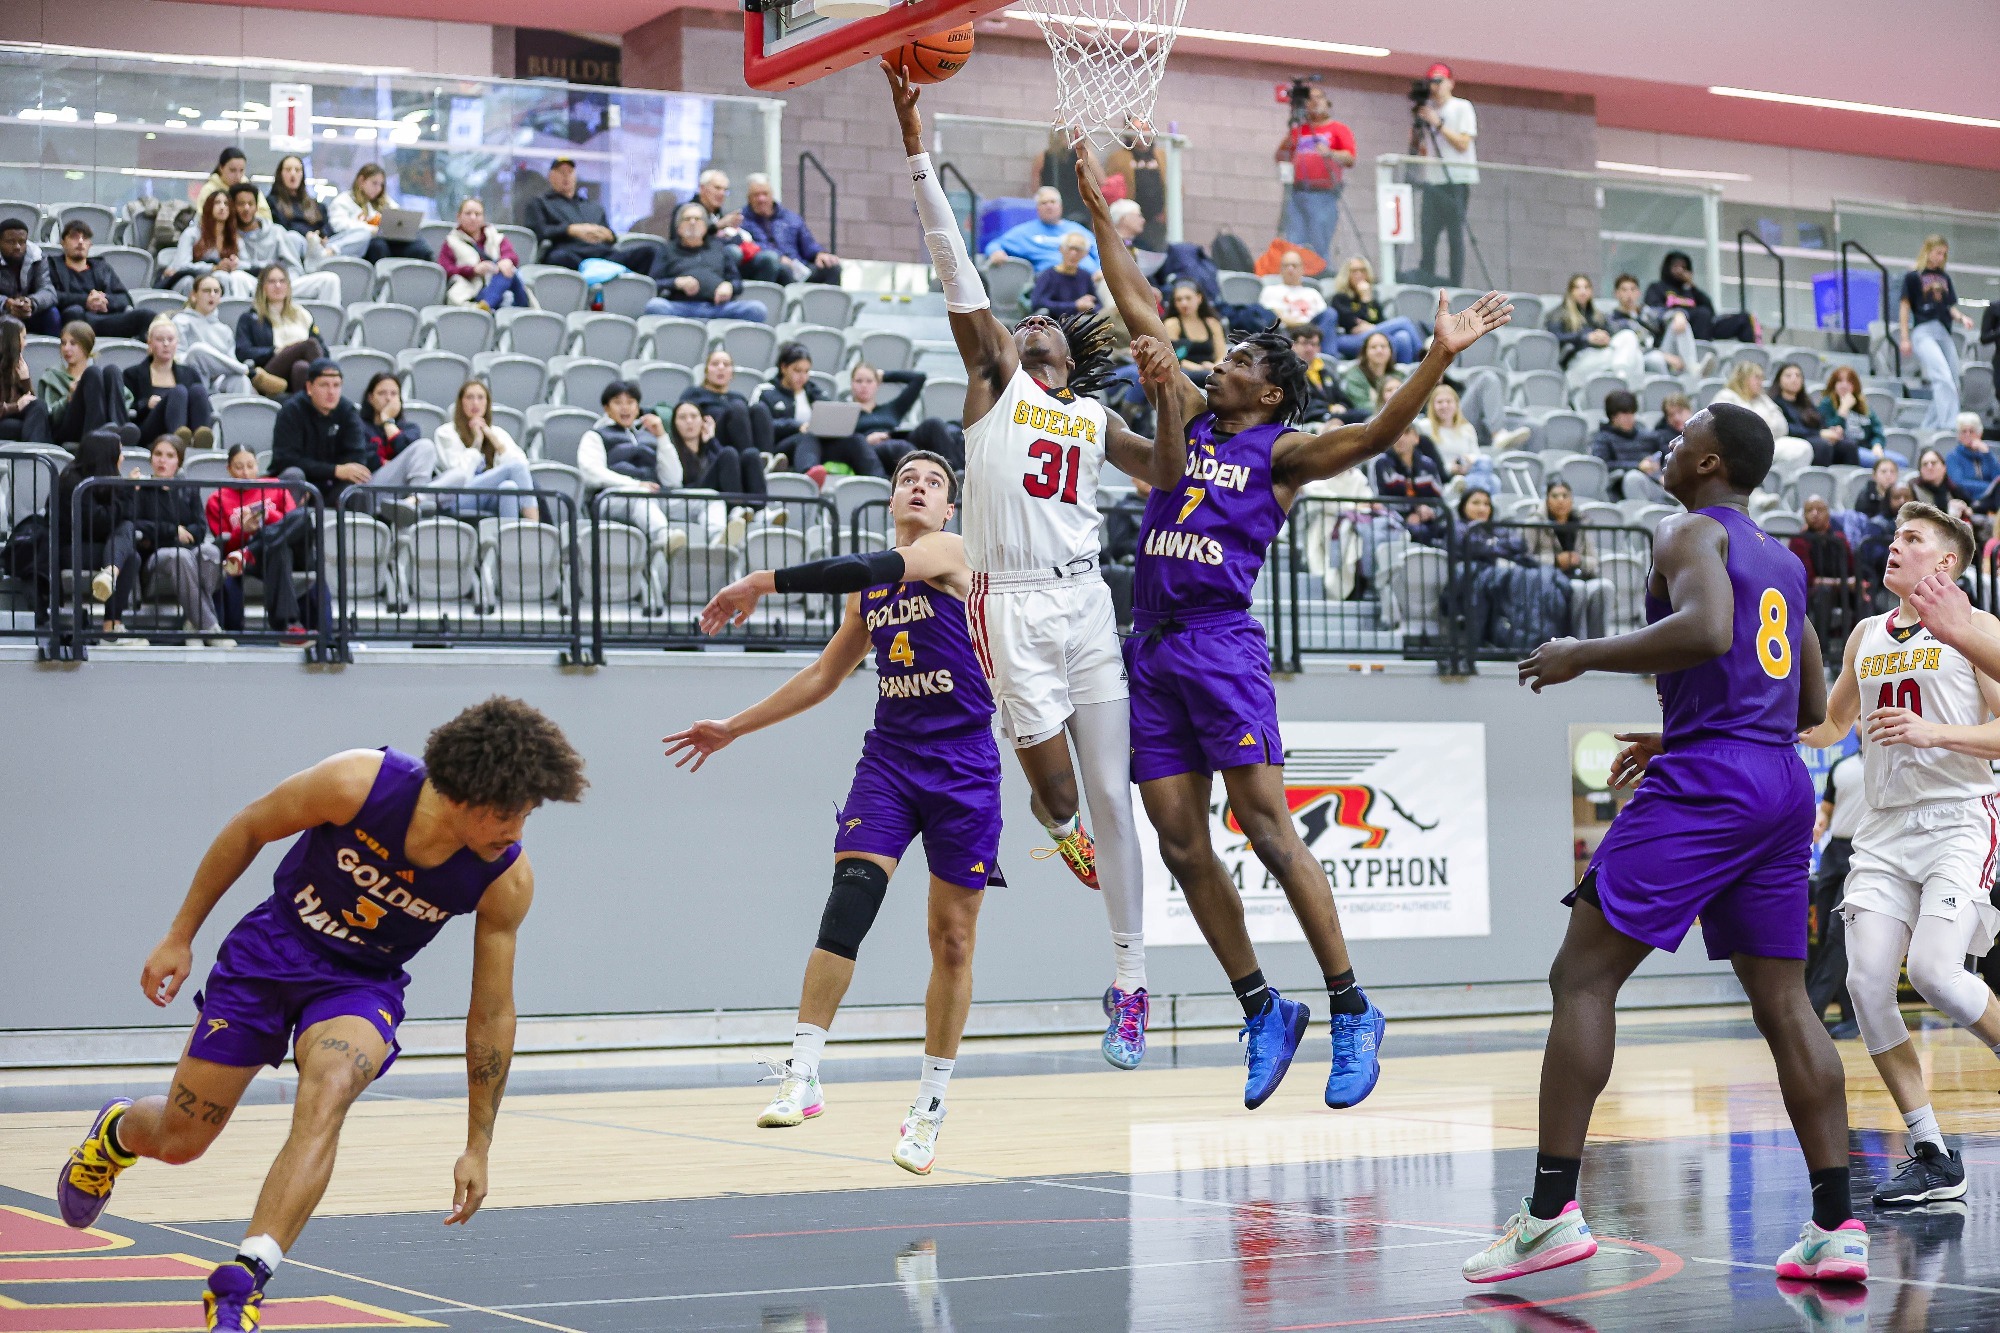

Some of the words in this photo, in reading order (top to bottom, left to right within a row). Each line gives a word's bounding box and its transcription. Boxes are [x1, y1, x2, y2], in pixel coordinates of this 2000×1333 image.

[1392, 195, 1402, 236] J
[1013, 399, 1097, 445] GUELPH
[1022, 438, 1081, 505] 31
[1184, 450, 1251, 493] OLDEN
[1175, 486, 1206, 525] 7
[866, 595, 936, 632] GOLDEN
[1755, 587, 1792, 680] 8
[889, 630, 915, 668] 4
[1859, 647, 1942, 680] GUELPH
[880, 669, 955, 699] HAWKS
[337, 847, 449, 923] GOLDEN
[1320, 857, 1448, 888] RYPHON
[294, 883, 394, 954] HAW
[341, 895, 388, 930] 3
